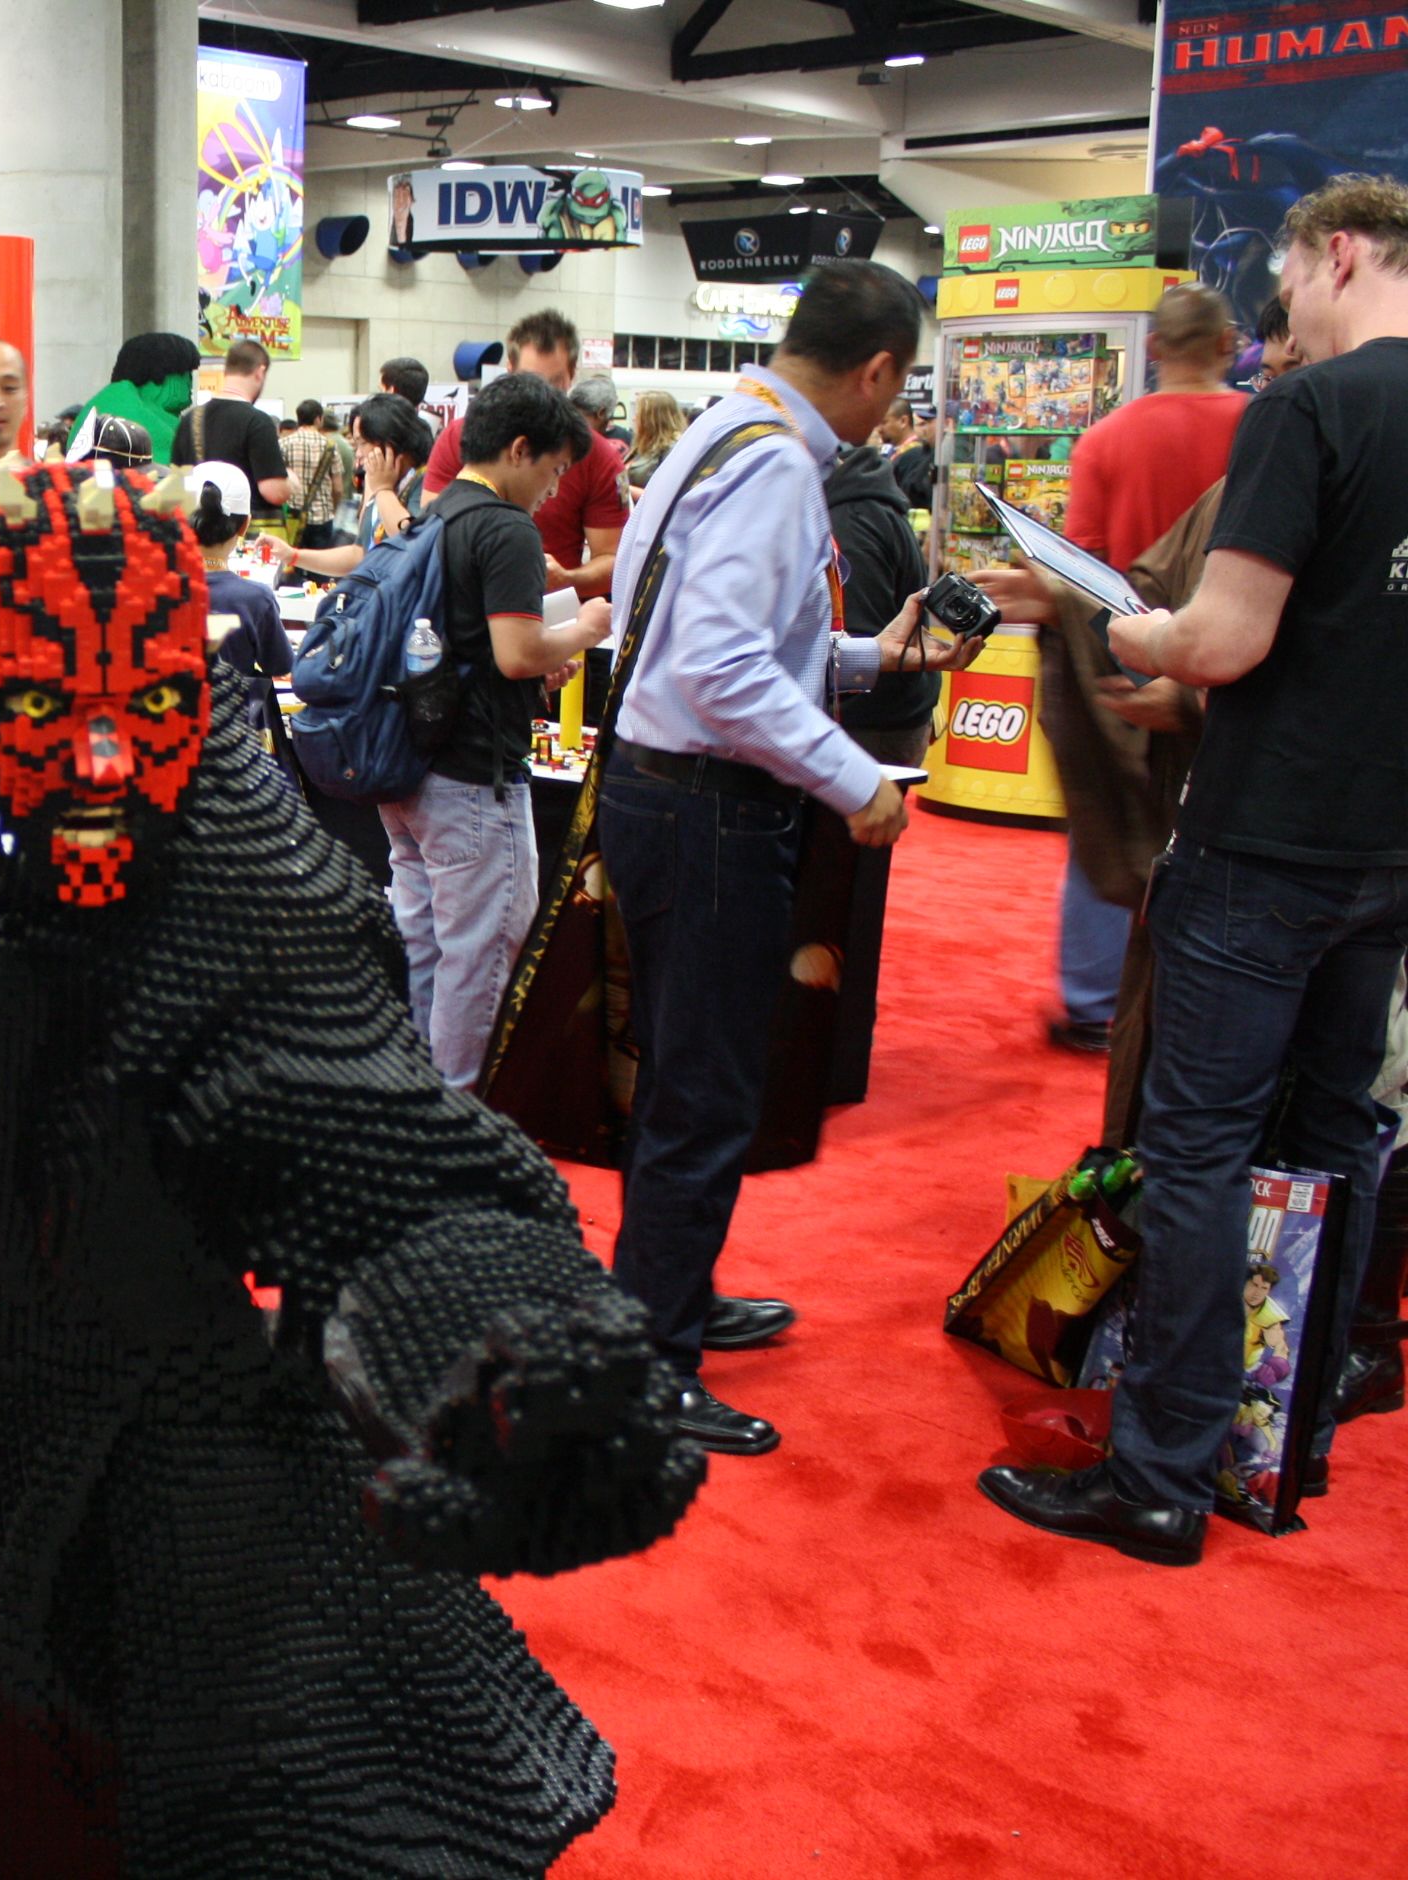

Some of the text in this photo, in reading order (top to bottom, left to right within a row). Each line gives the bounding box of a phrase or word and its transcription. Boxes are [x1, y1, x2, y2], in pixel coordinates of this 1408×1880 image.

[438, 181, 547, 226] IDW
[961, 220, 1111, 260] LEGO NINJAGO
[699, 254, 800, 272] RODDENBERRY
[996, 291, 1017, 300] LEGO
[225, 304, 291, 329] ADVENTURE
[951, 700, 1025, 742] LEGO
